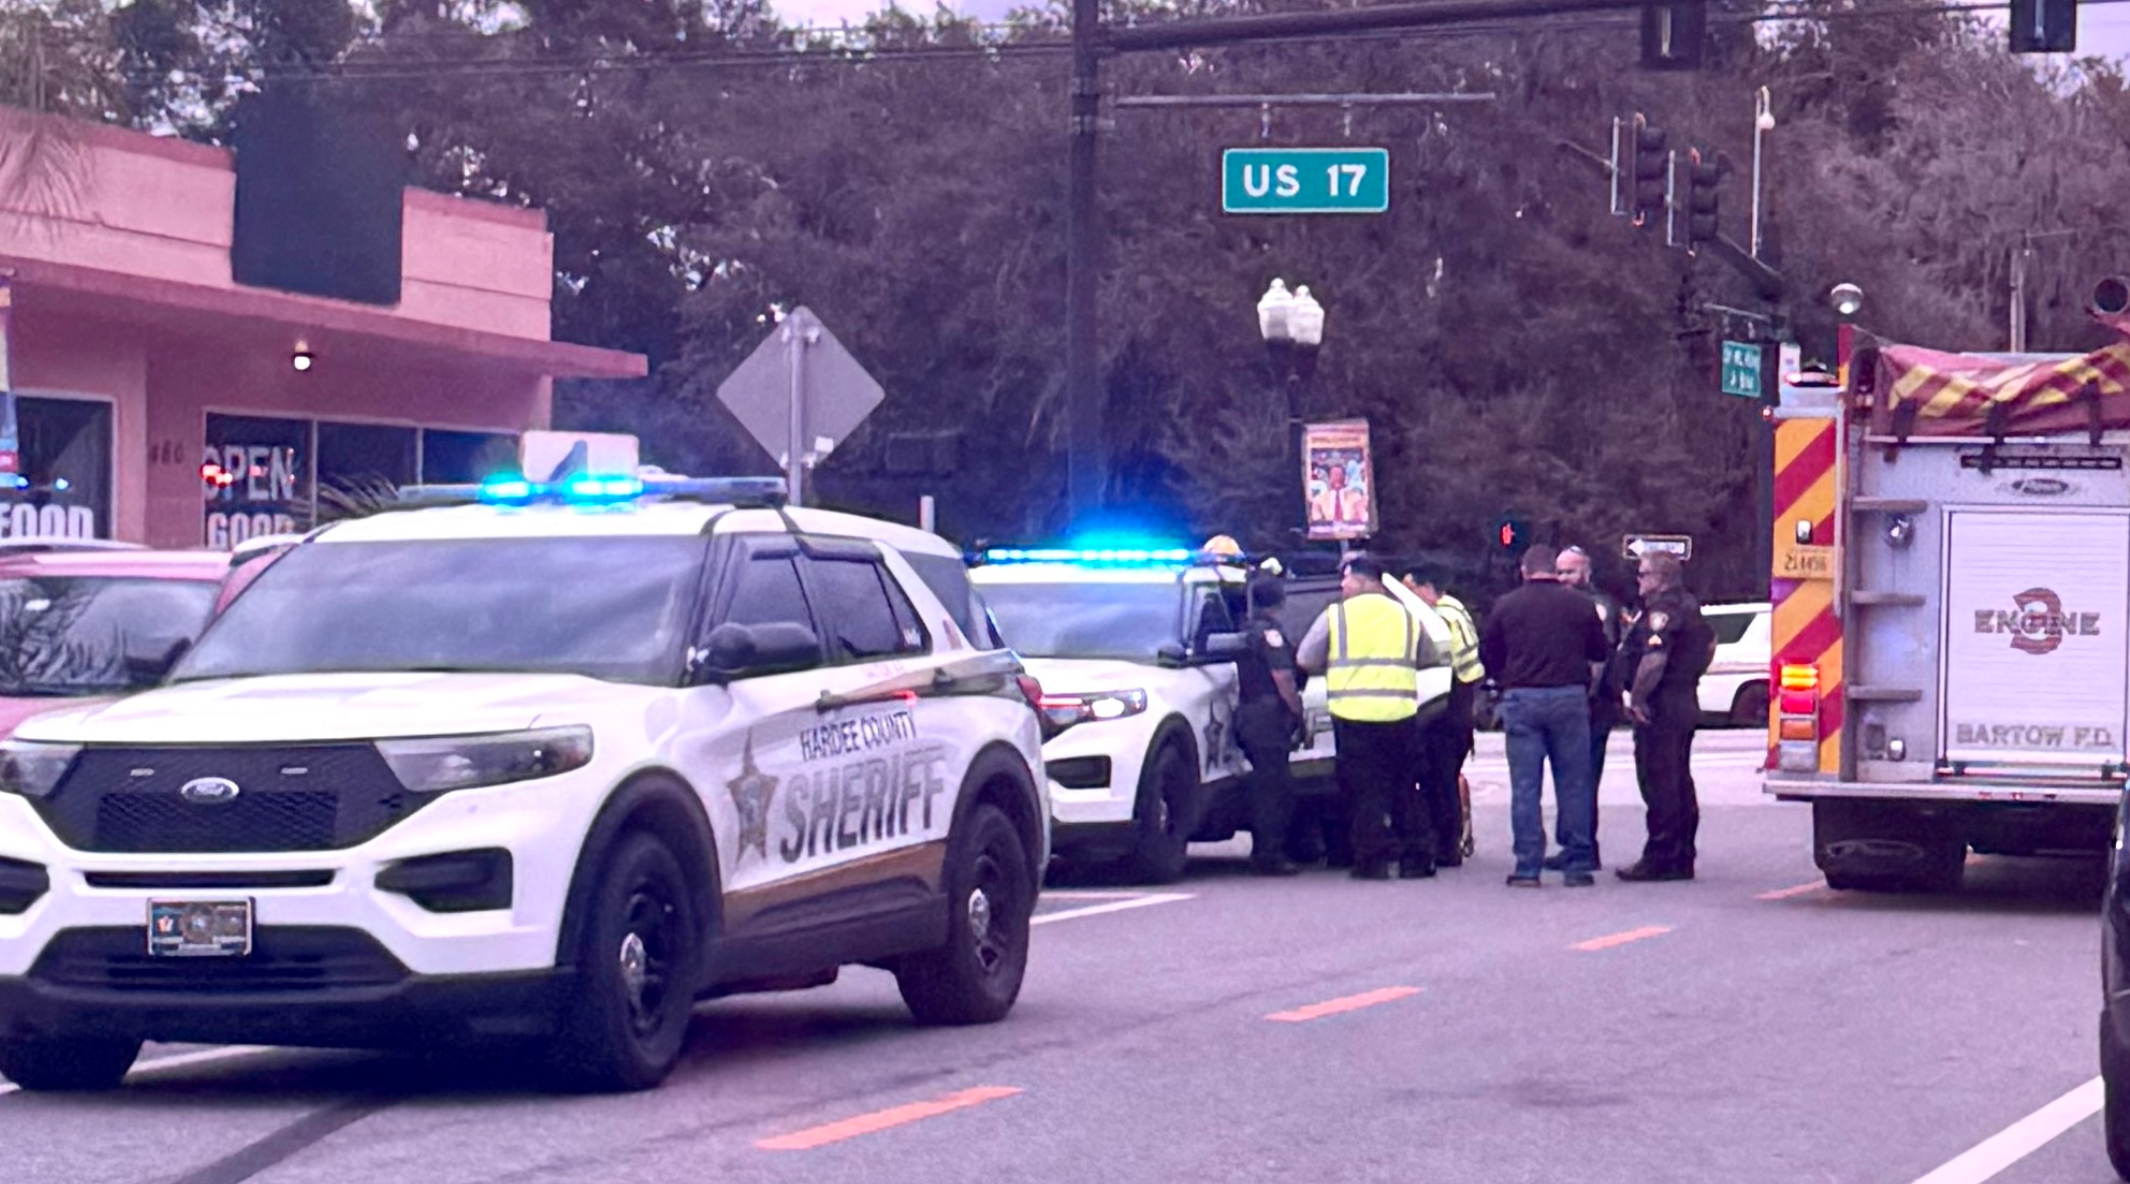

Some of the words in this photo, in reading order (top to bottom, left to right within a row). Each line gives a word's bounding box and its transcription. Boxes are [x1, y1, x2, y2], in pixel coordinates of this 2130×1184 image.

[1243, 163, 1300, 197] US
[1326, 163, 1367, 197] 17
[202, 445, 294, 500] OPEN
[1974, 609, 2101, 636] ENGINE
[800, 719, 861, 763] HARDEE
[860, 710, 917, 749] COUNTY
[1955, 723, 2065, 747] BARTOW
[780, 744, 945, 864] SHERIFF
